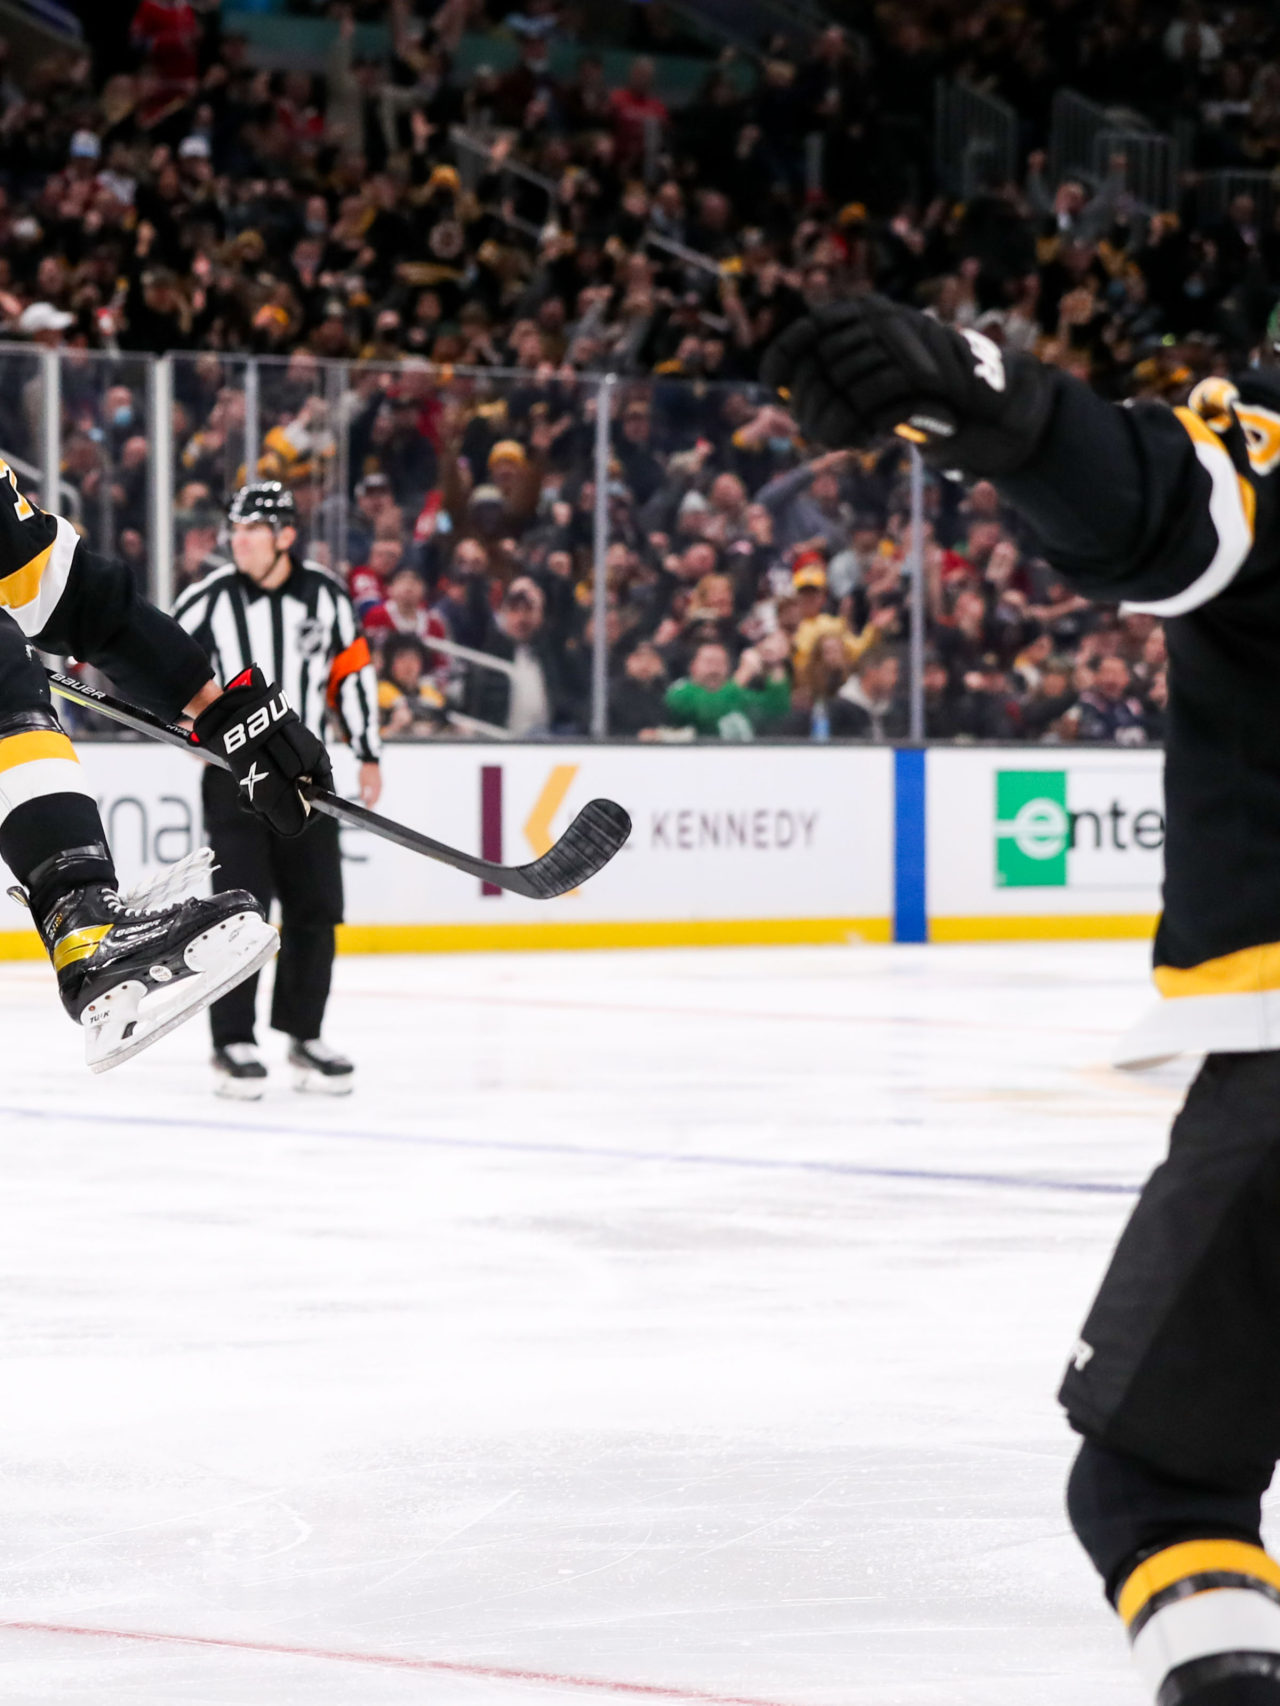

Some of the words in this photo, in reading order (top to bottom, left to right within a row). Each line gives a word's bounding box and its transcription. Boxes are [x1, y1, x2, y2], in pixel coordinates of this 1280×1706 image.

[223, 689, 292, 754] BAU
[650, 808, 821, 851] KENNEDY
[996, 796, 1164, 863] ente
